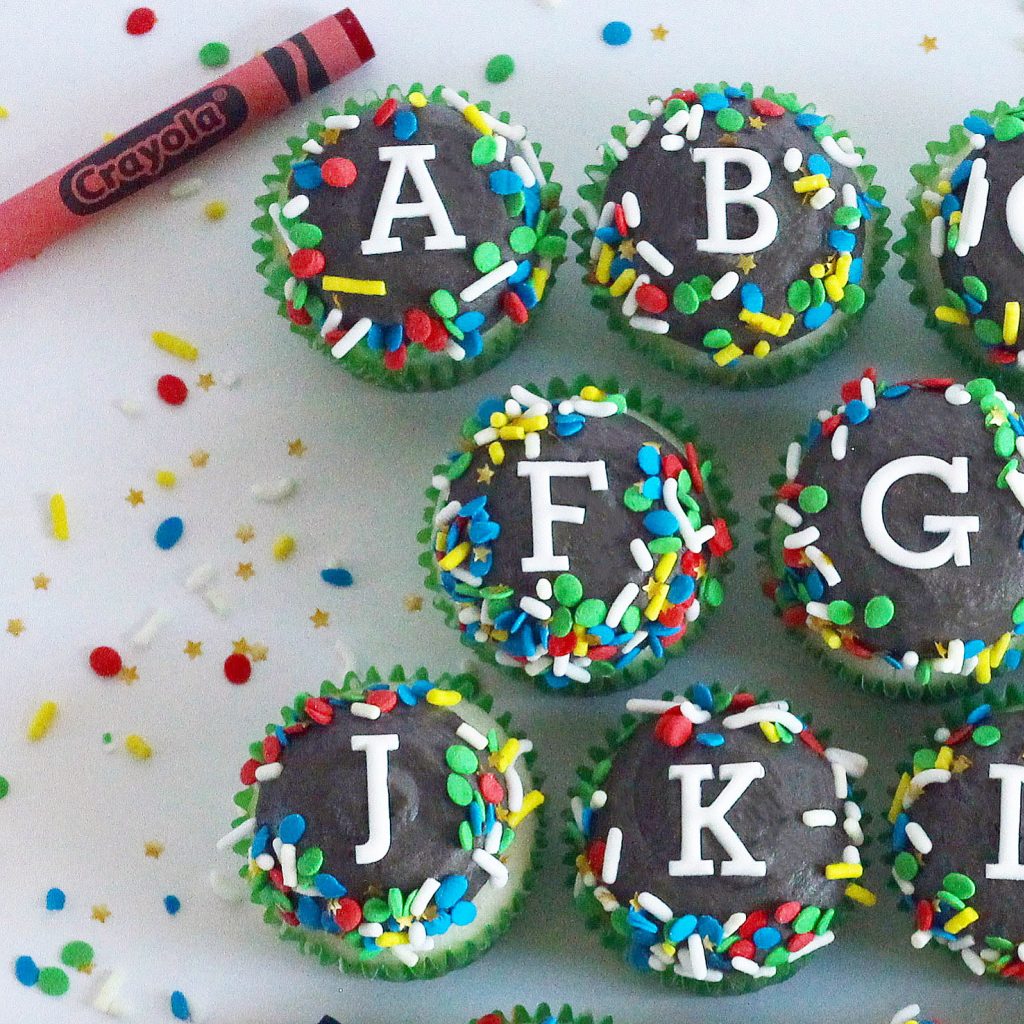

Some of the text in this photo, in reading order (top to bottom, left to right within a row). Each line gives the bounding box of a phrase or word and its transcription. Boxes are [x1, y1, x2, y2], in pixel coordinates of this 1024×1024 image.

[71, 102, 227, 203] Crayola
[361, 145, 466, 254] A
[693, 148, 778, 255] B
[518, 460, 608, 572] F
[861, 456, 979, 569] G
[351, 734, 399, 864] J
[669, 762, 766, 876] K
